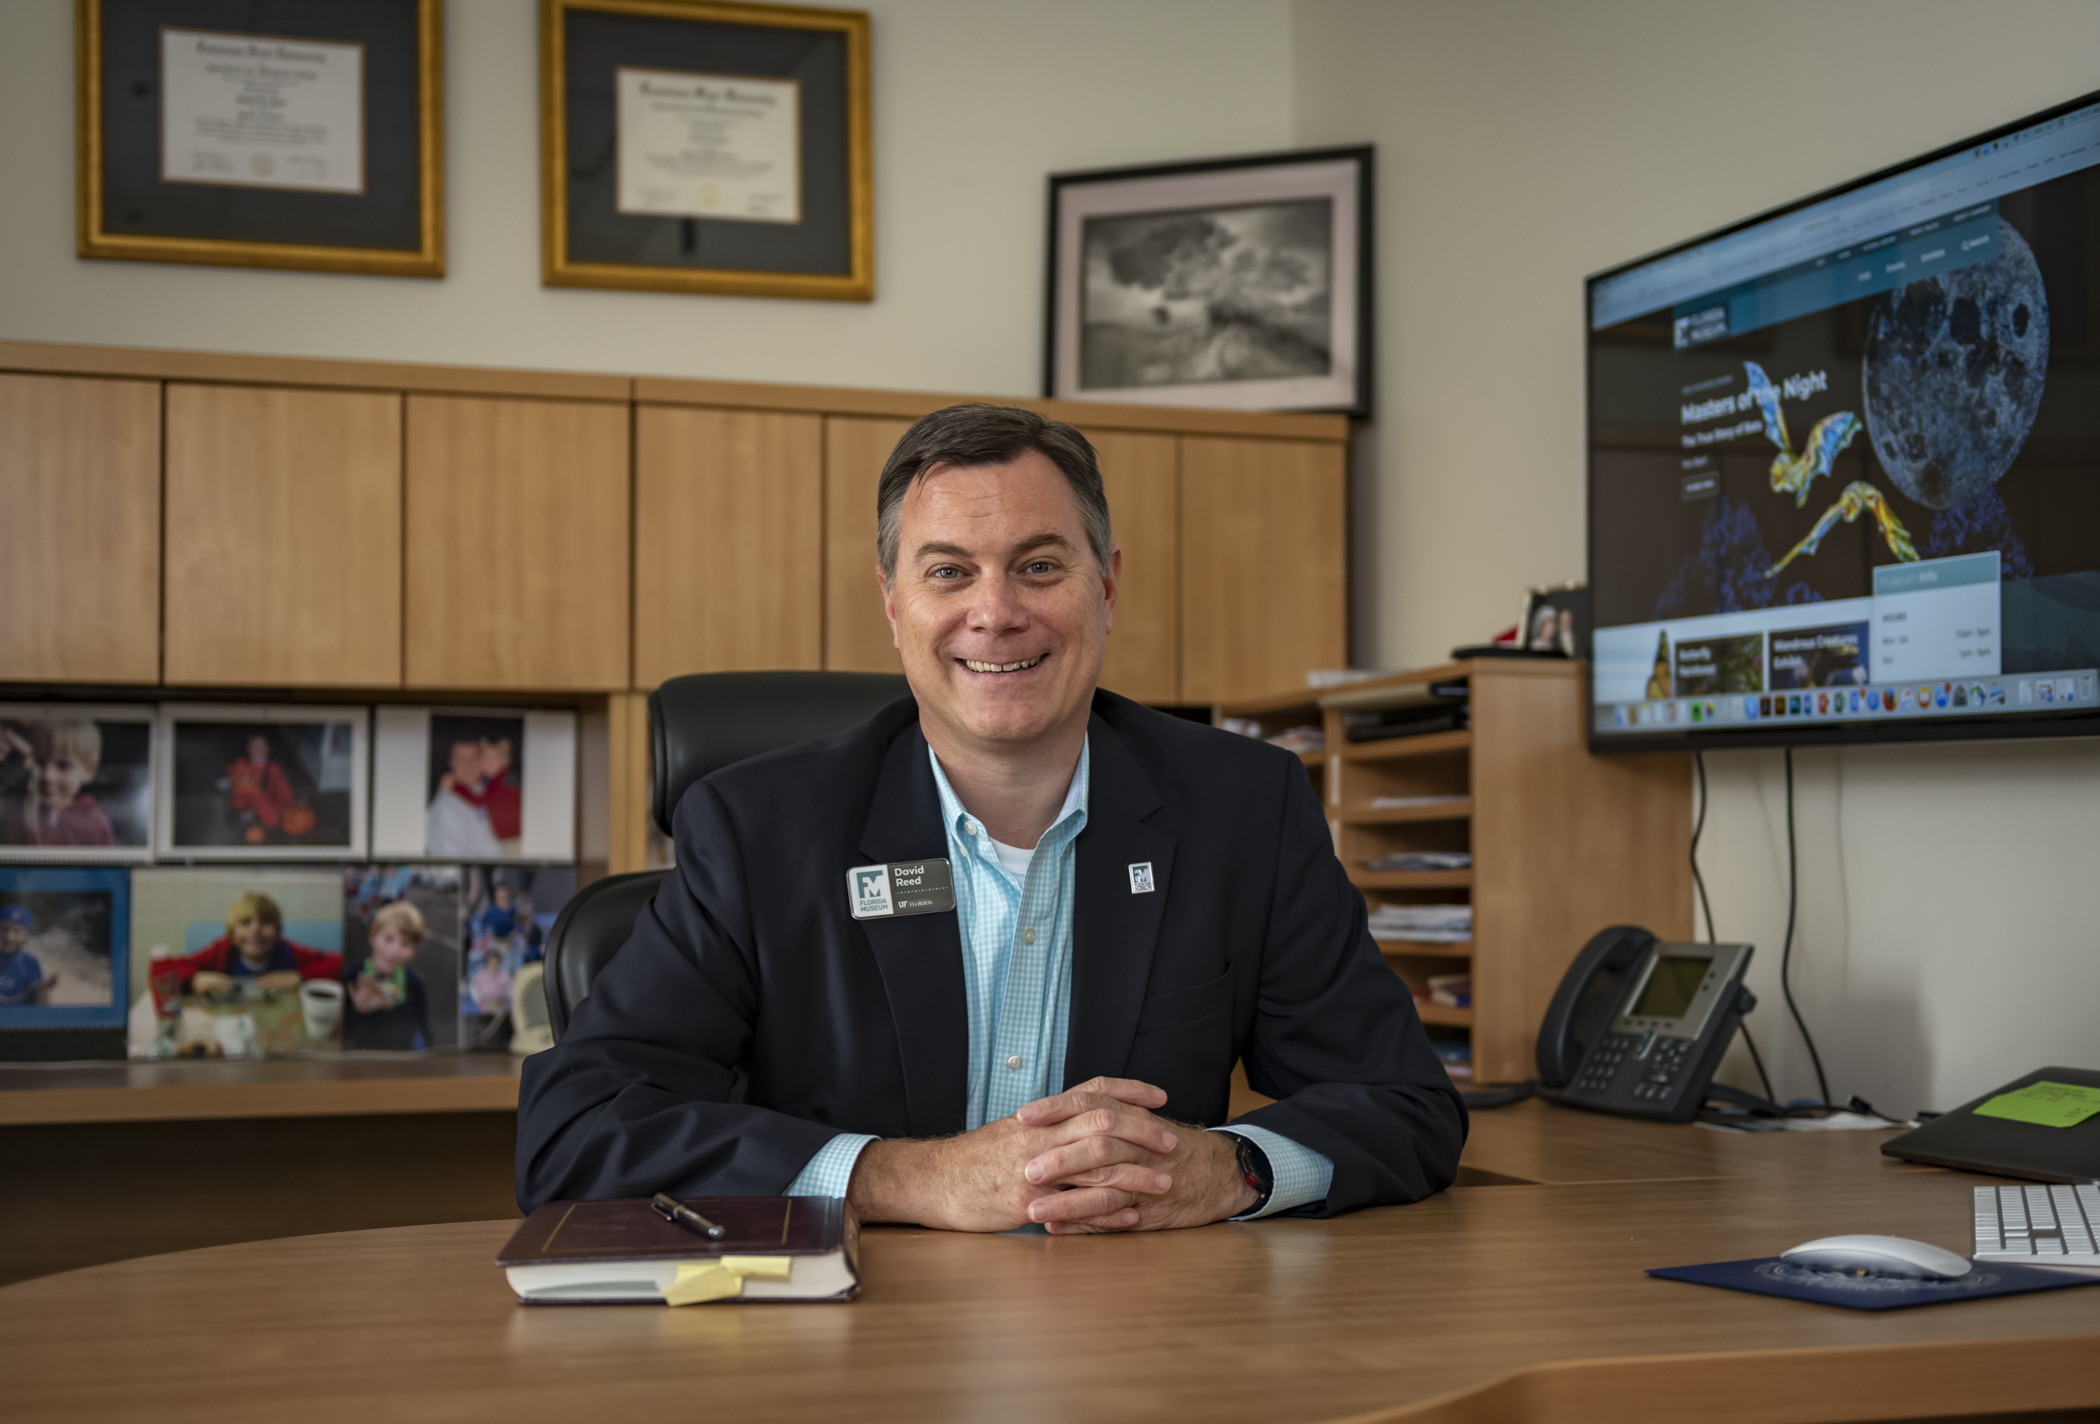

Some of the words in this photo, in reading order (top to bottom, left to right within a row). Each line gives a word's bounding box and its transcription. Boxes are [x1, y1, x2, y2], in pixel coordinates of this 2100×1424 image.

[1681, 396, 1736, 425] Masters
[1737, 389, 1754, 412] of
[1783, 369, 1828, 401] Night
[894, 865, 924, 876] David
[896, 877, 921, 887] Reed
[860, 898, 887, 907] FLORIDA
[898, 900, 908, 908] UF
[861, 904, 888, 913] MUSEUM
